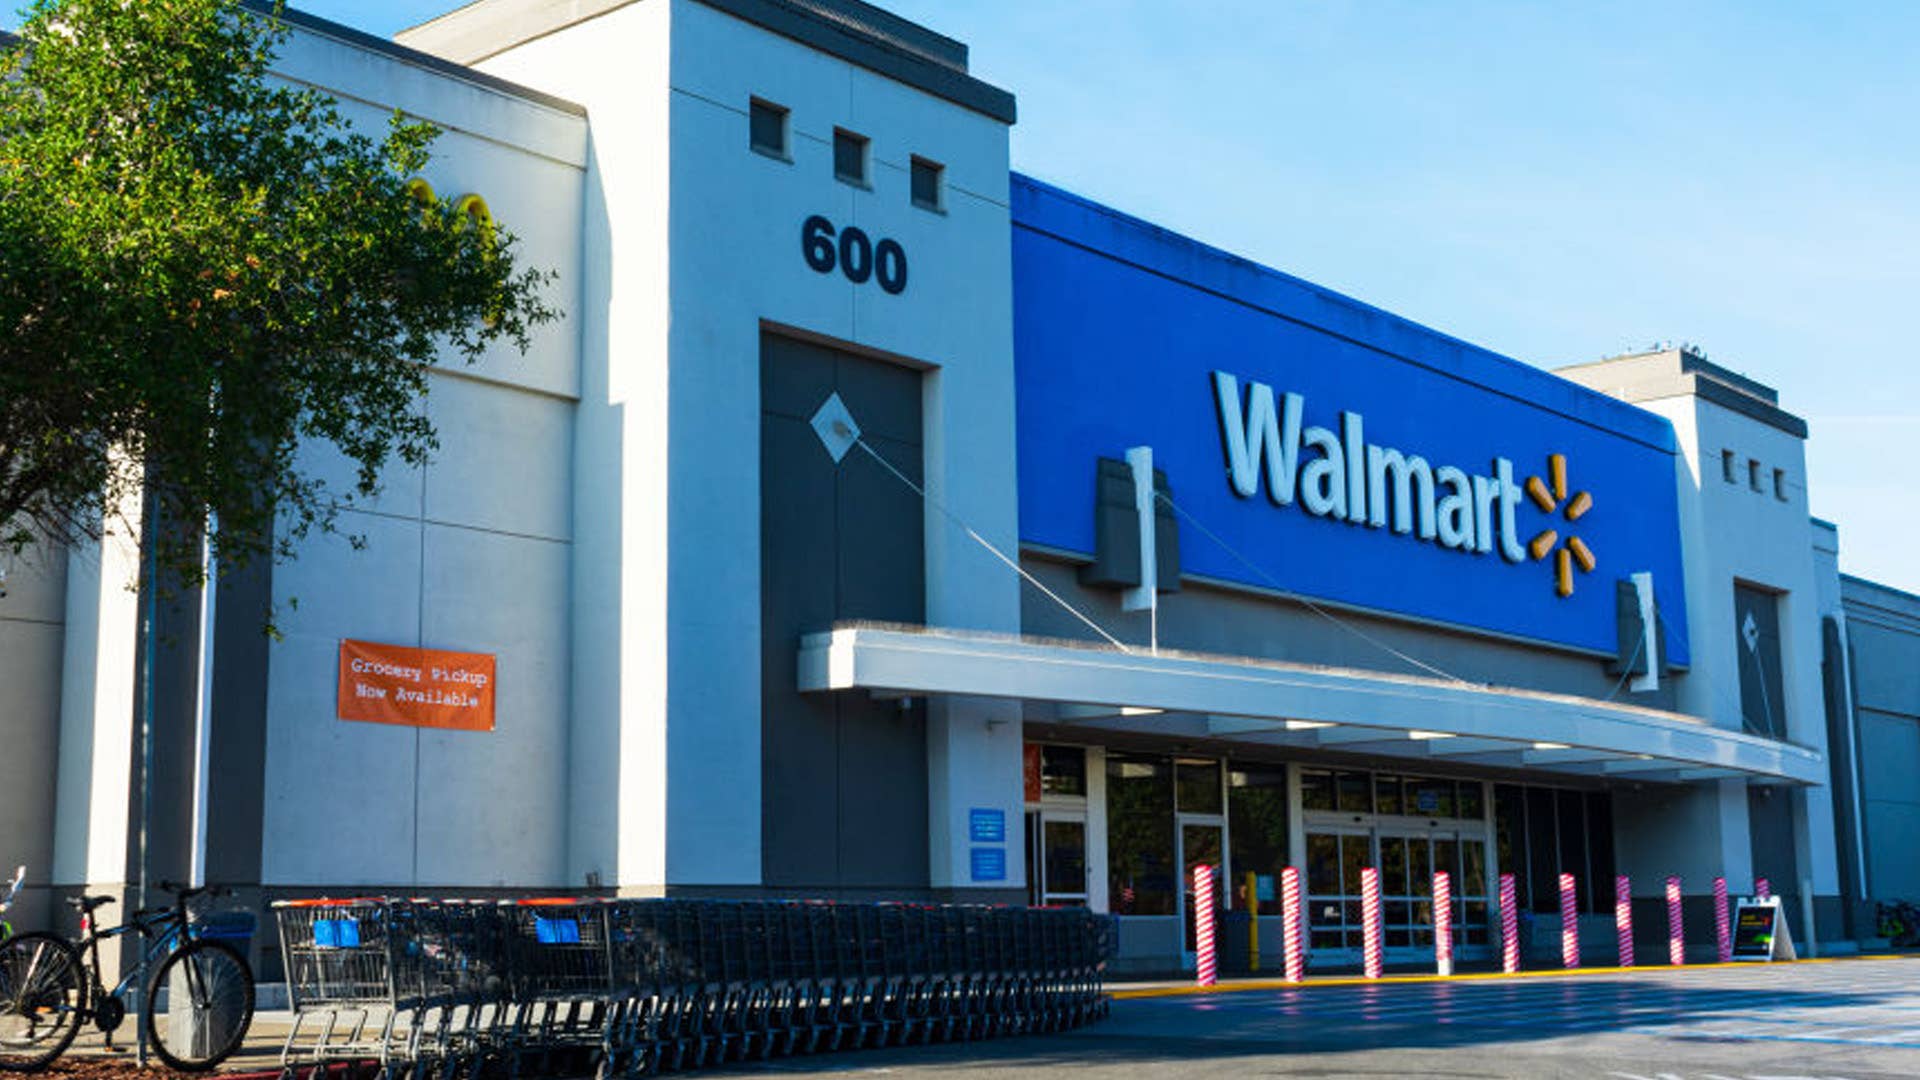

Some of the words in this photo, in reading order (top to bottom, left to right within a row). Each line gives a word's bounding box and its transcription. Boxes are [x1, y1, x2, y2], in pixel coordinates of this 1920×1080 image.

[802, 214, 908, 295] 600
[1213, 369, 1526, 563] Walmart
[351, 659, 421, 681] Grocery
[432, 669, 487, 687] Pickup
[355, 684, 387, 699] Now
[396, 688, 478, 706] Available
